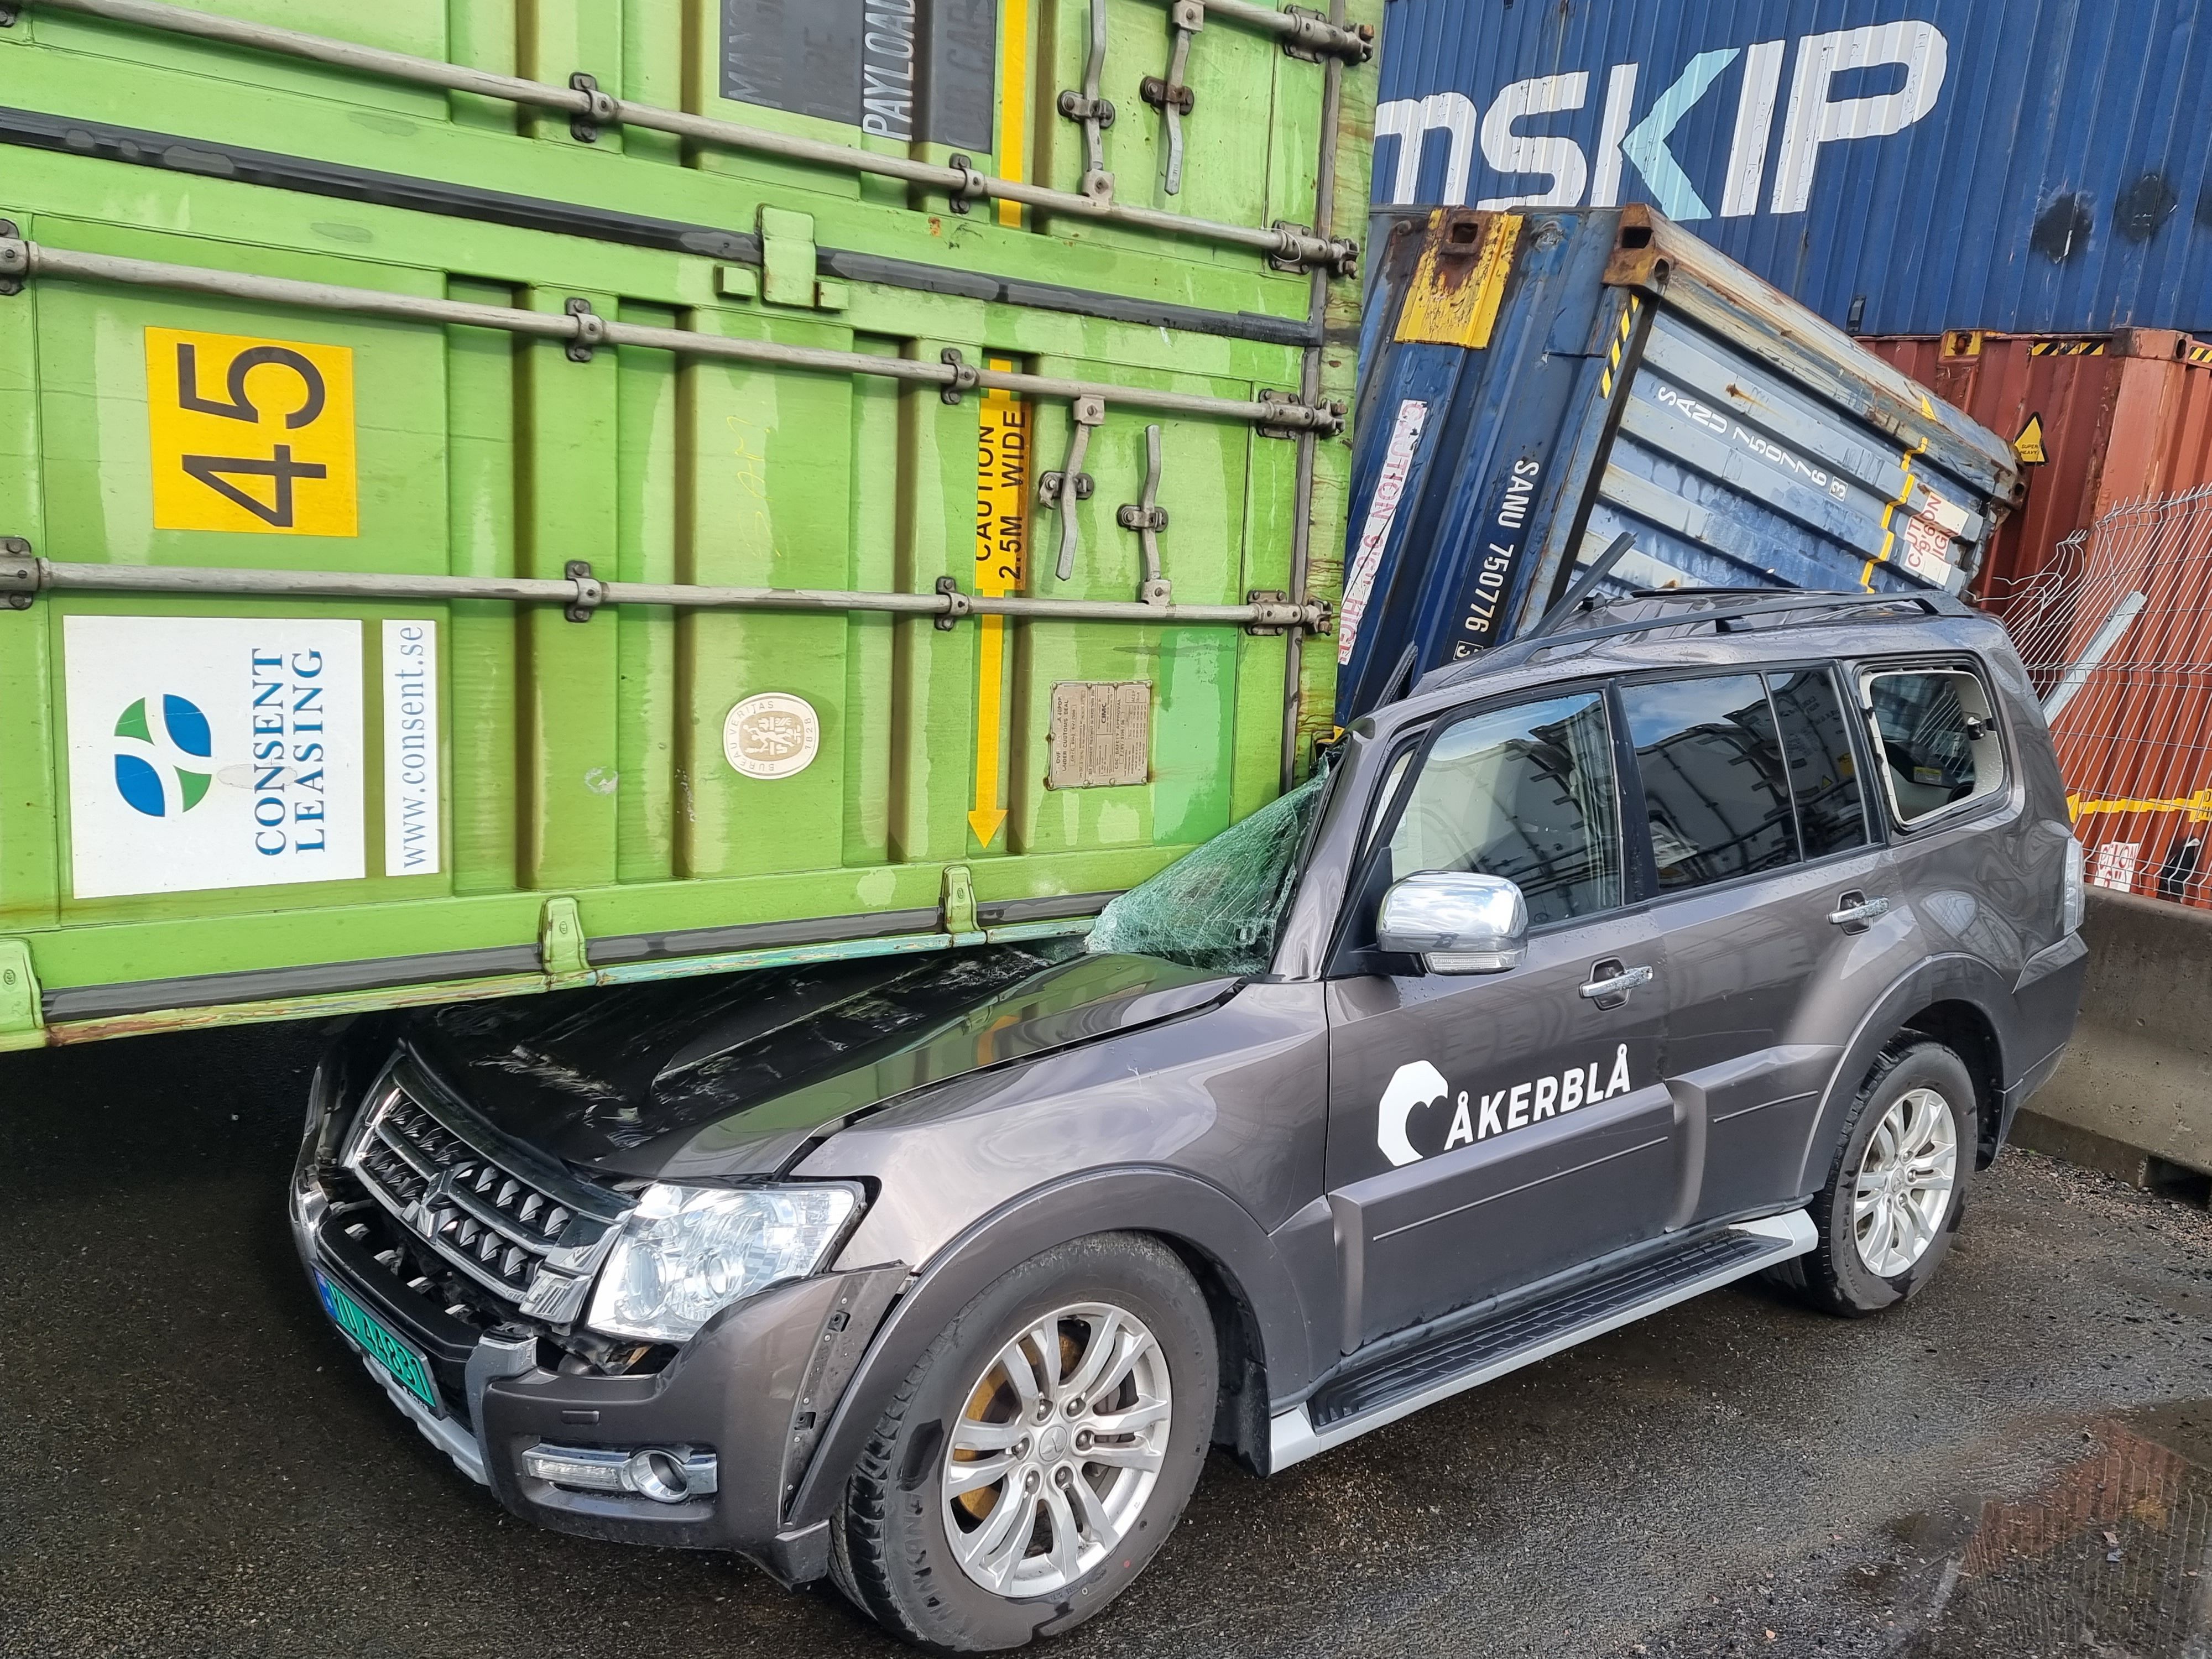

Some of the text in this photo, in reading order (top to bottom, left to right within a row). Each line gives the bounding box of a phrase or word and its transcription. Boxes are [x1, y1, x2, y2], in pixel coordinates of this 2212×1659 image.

[863, 0, 915, 142] PAYLOAD
[176, 343, 327, 527] 45
[975, 426, 994, 561] CAUTION
[1369, 402, 1424, 521] CAUTION
[1658, 386, 1847, 500] SANU 750776 3
[999, 410, 1025, 580] 2.5M WIDE
[1498, 459, 1540, 529] SANU
[1906, 495, 1942, 567] CAUTION
[1464, 543, 1515, 633] 750776
[251, 648, 286, 856] CONSENT
[291, 648, 325, 854] LEASING
[394, 625, 427, 869] www.consent.se
[729, 701, 775, 771] BUREAU VERITAS
[804, 718, 813, 750] 1828
[1444, 1043, 1630, 1151] ÅKERBLÅ
[326, 1281, 359, 1334] YU
[363, 1315, 429, 1397] 44831
